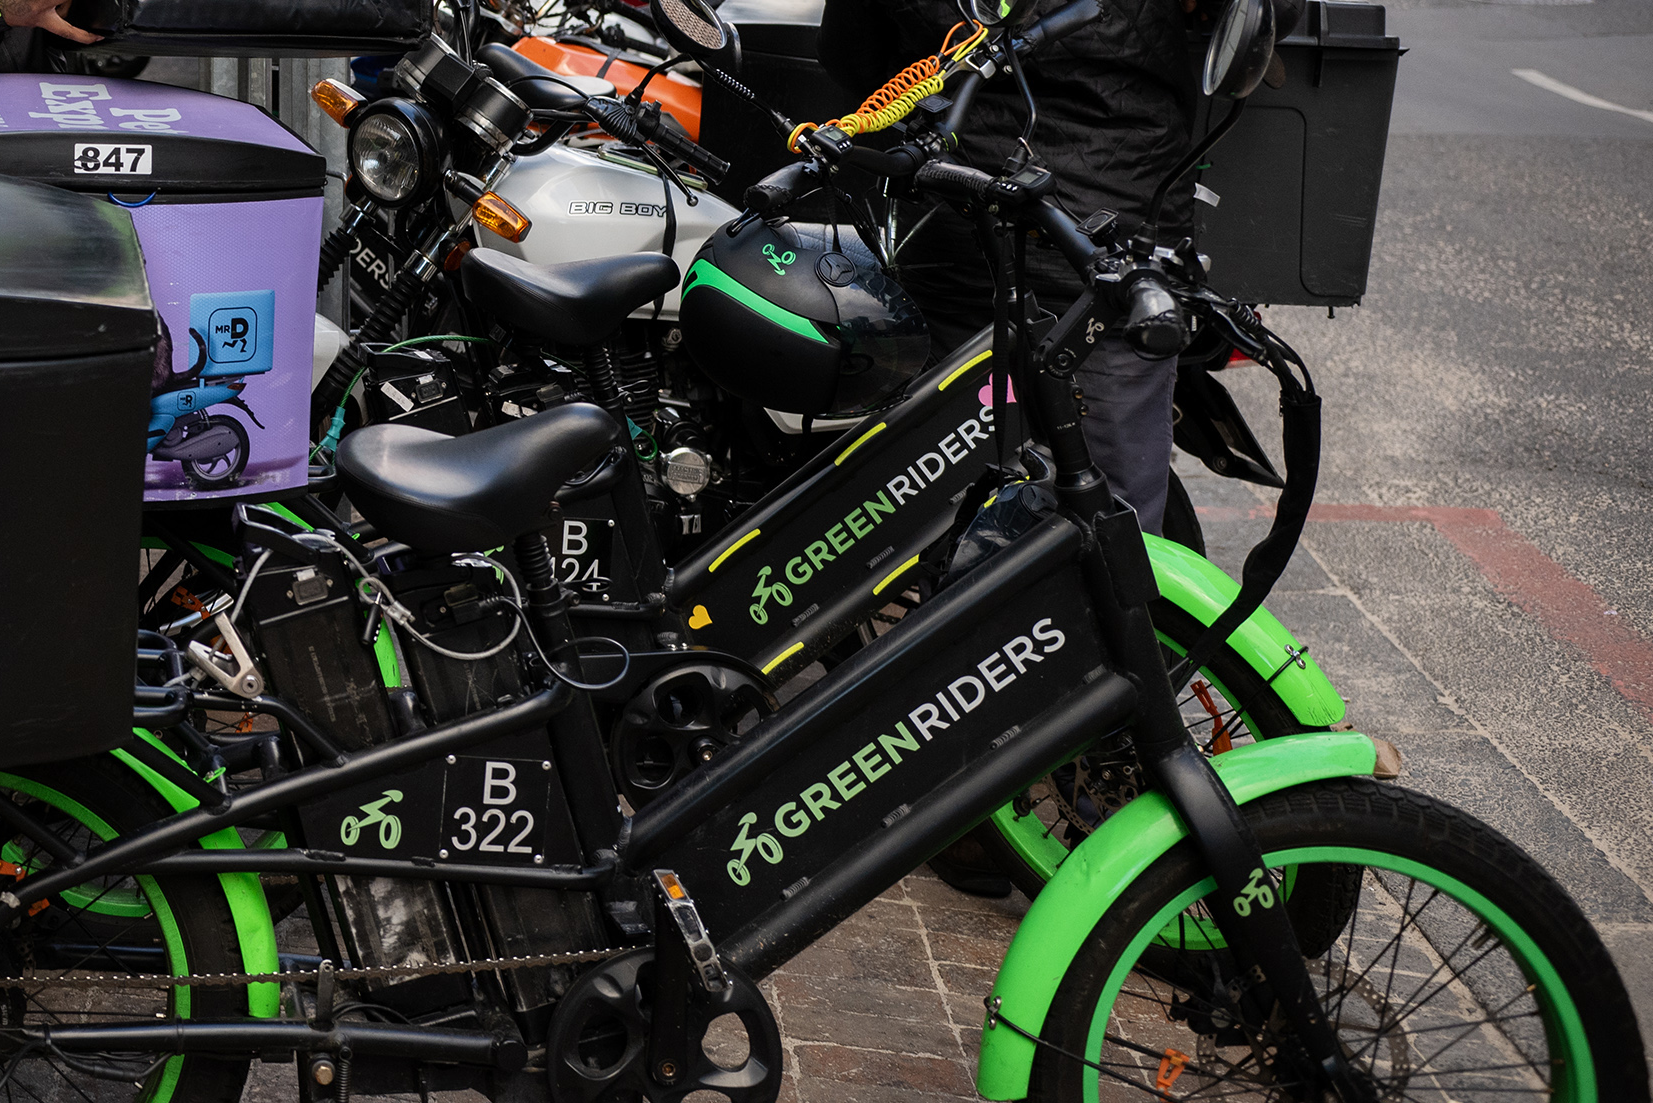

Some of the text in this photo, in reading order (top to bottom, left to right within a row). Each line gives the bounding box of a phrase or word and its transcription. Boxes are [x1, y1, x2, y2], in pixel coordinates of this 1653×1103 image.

[81, 147, 145, 172] 847
[569, 201, 666, 217] BIG BOY
[215, 318, 249, 339] MR D
[562, 520, 588, 555] B
[483, 761, 517, 805] B
[451, 807, 534, 853] 322
